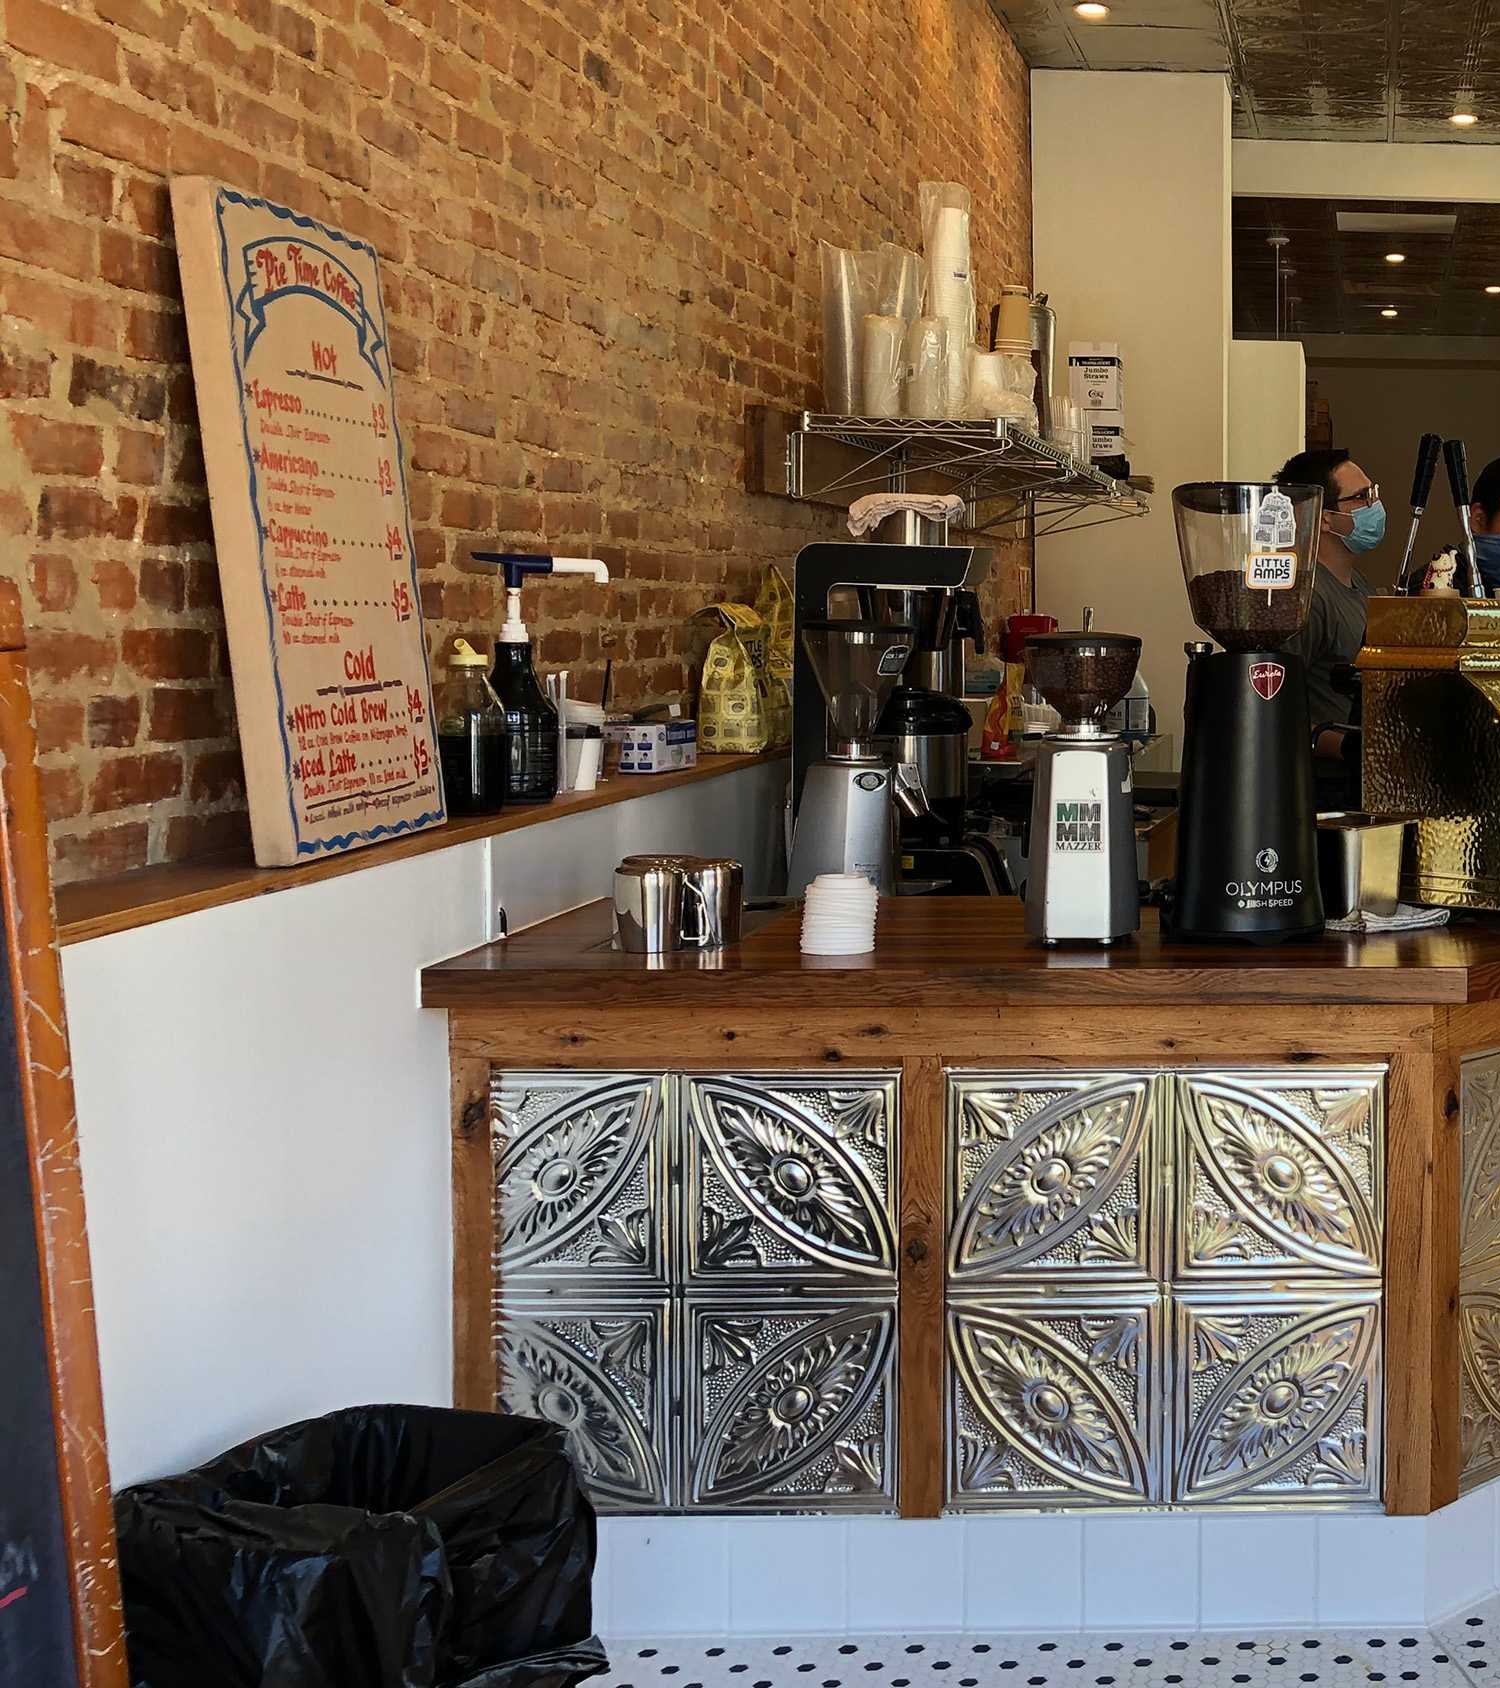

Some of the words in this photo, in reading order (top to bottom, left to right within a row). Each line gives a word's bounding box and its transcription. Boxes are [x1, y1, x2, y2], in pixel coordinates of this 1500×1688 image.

[256, 248, 287, 294] Pie
[287, 244, 320, 288] Time
[323, 262, 356, 310] Coffee
[253, 378, 302, 417] Espresso
[260, 442, 319, 480] Americano
[268, 518, 329, 549] Cappuccino
[1254, 568, 1291, 579] AMPS
[1255, 558, 1291, 568] LITTLE
[277, 582, 307, 612] Latte
[744, 640, 762, 653] TTLE
[344, 645, 376, 682] Cold
[294, 703, 326, 733] Nitro
[330, 698, 358, 727] Cold
[360, 697, 388, 724] Brew
[300, 750, 326, 782] Iced
[329, 749, 358, 777] Latte
[1056, 842, 1101, 851] MAZZER
[1226, 880, 1303, 897] OLYMPUS
[1268, 899, 1293, 908] SPEED
